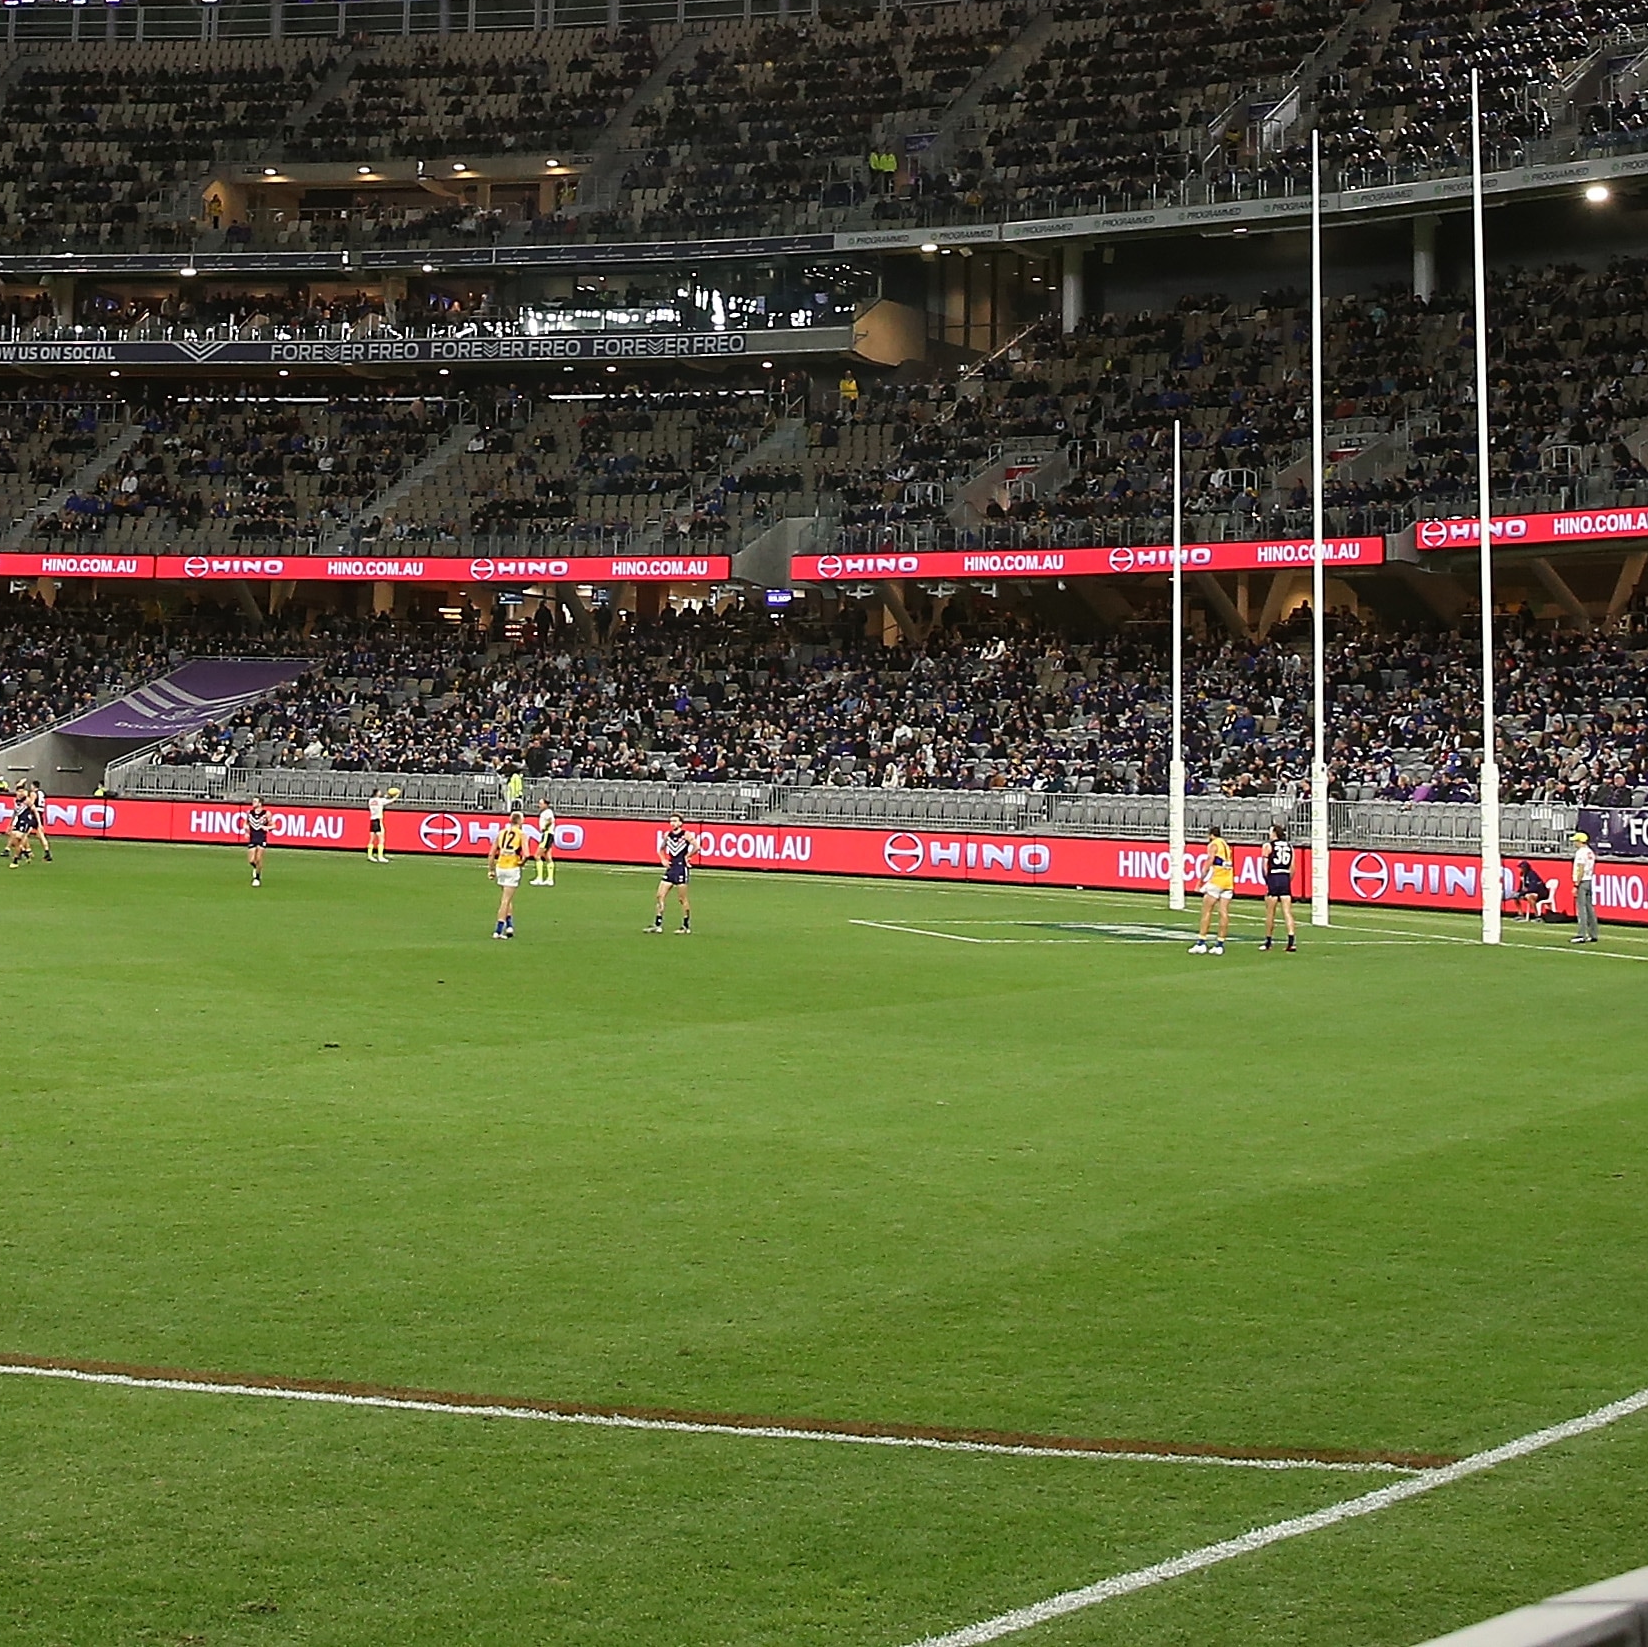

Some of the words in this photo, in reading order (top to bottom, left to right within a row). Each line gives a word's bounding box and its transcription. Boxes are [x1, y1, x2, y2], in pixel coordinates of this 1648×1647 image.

[368, 342, 420, 361] FREO
[527, 339, 581, 357] FREO
[693, 334, 745, 353] FREO
[18, 346, 39, 360] US
[41, 346, 62, 360] ON
[66, 346, 116, 360] SOCIAL
[1256, 542, 1360, 563] HINO.CM.AU
[41, 558, 137, 574] HINO.COM.AU
[211, 559, 284, 574] HINO
[327, 561, 424, 576] HINO.COM.AU
[497, 560, 569, 576] HINO
[611, 560, 708, 576] HINO.COM.AU
[845, 556, 919, 573] HINO
[963, 554, 1064, 572] HINO.COM.AU
[190, 809, 344, 839] HINOOM.AU
[468, 821, 584, 850] HNO
[501, 829, 516, 850] 12
[929, 841, 1050, 873] HINO
[1273, 844, 1292, 866] 36
